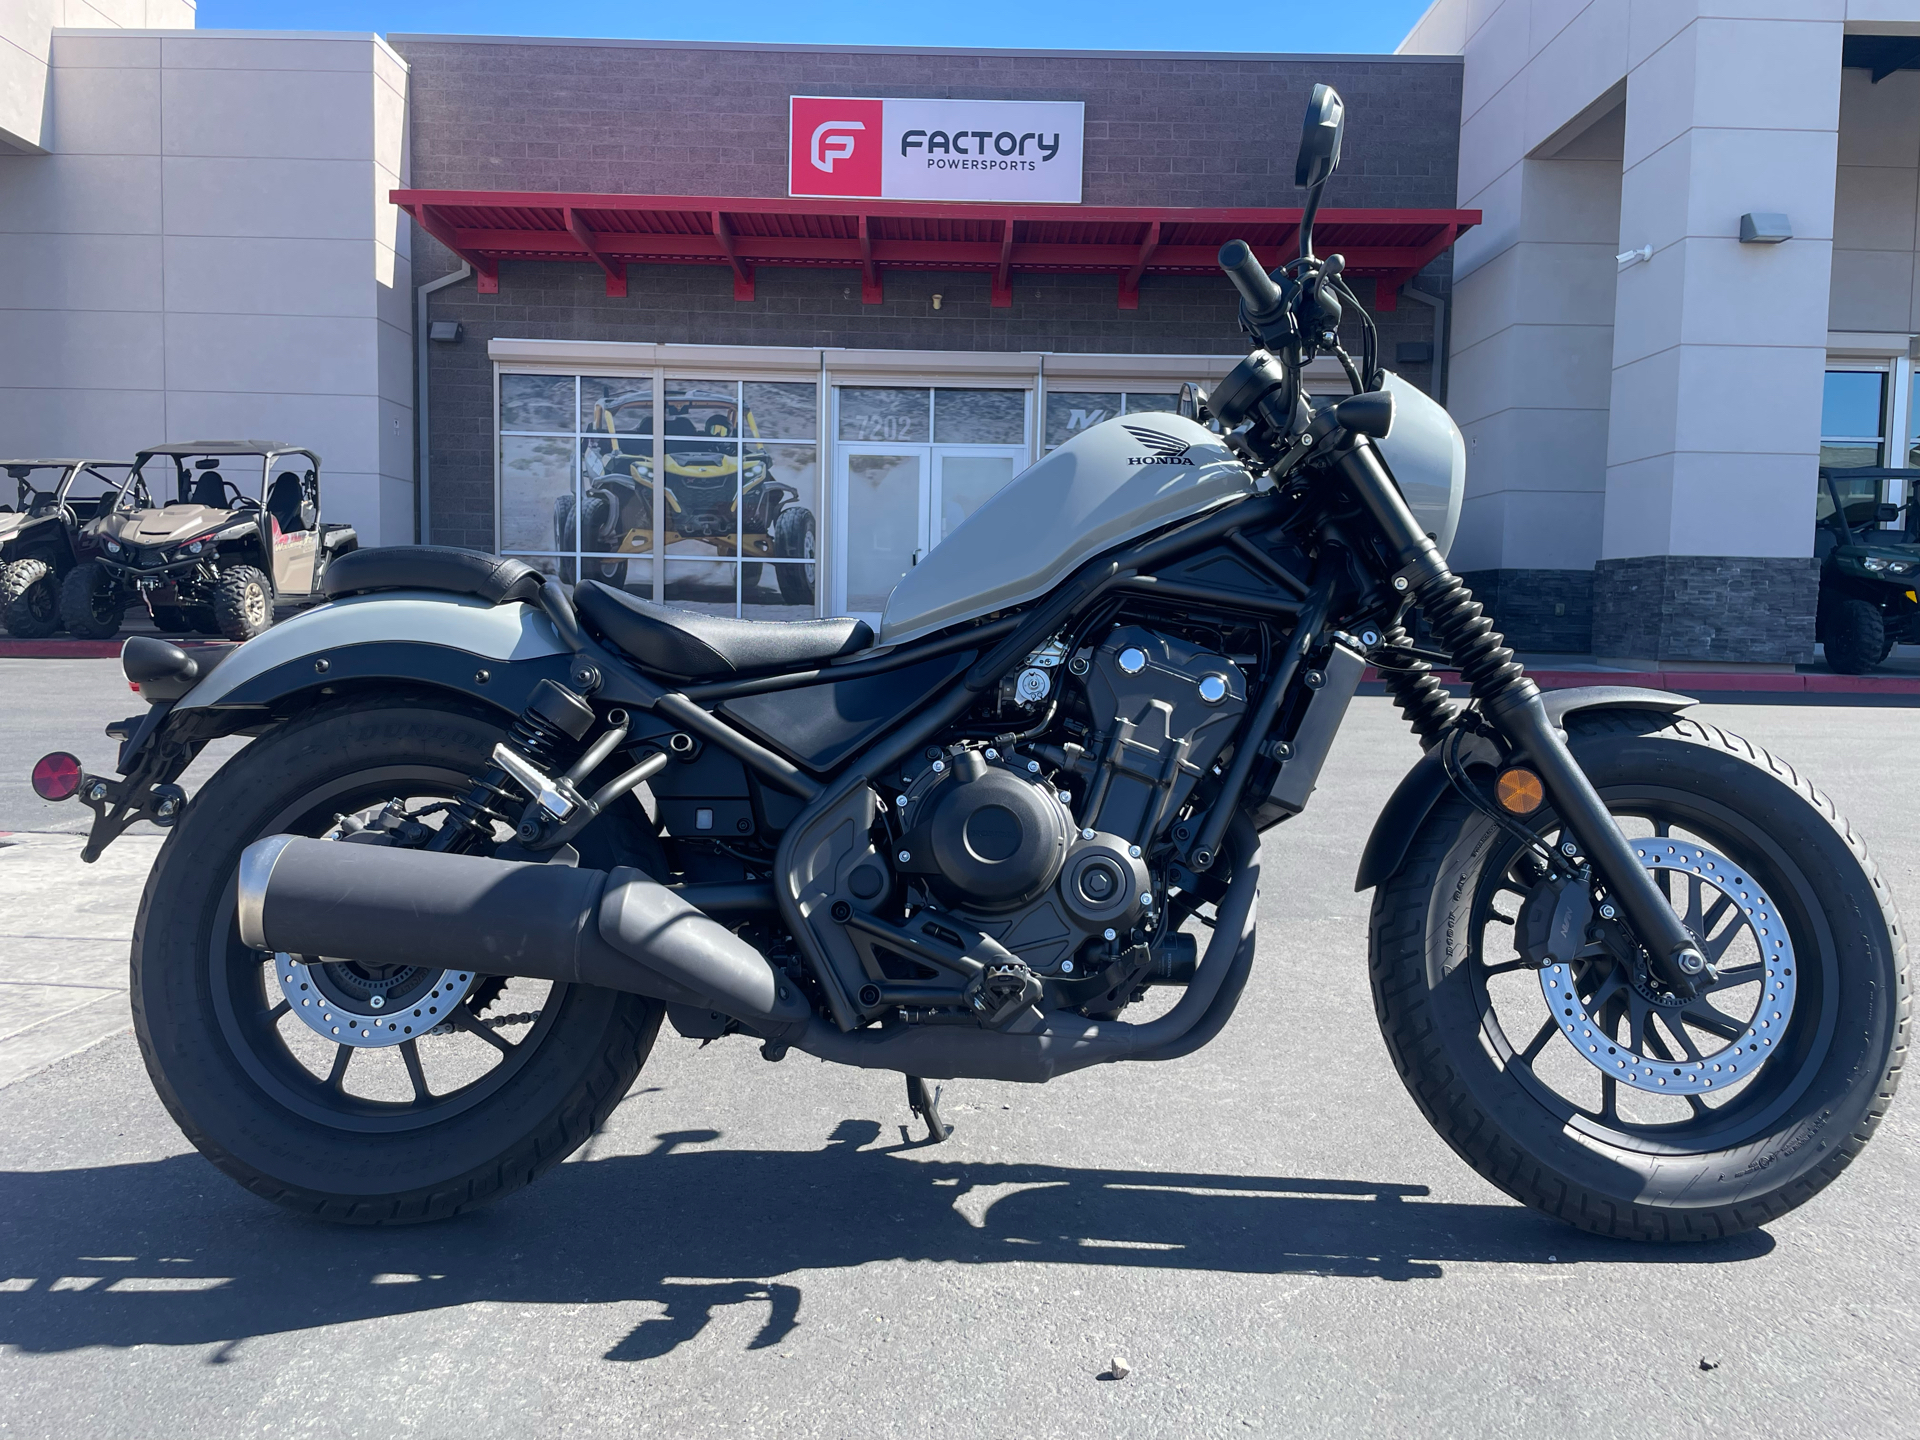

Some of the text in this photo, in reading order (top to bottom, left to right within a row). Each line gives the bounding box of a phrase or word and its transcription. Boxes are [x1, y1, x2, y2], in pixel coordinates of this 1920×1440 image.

[901, 130, 1060, 162] FACTORY
[927, 158, 1036, 171] POWERSPORTS
[856, 414, 912, 442] 7202
[1127, 456, 1195, 466] HONDA
